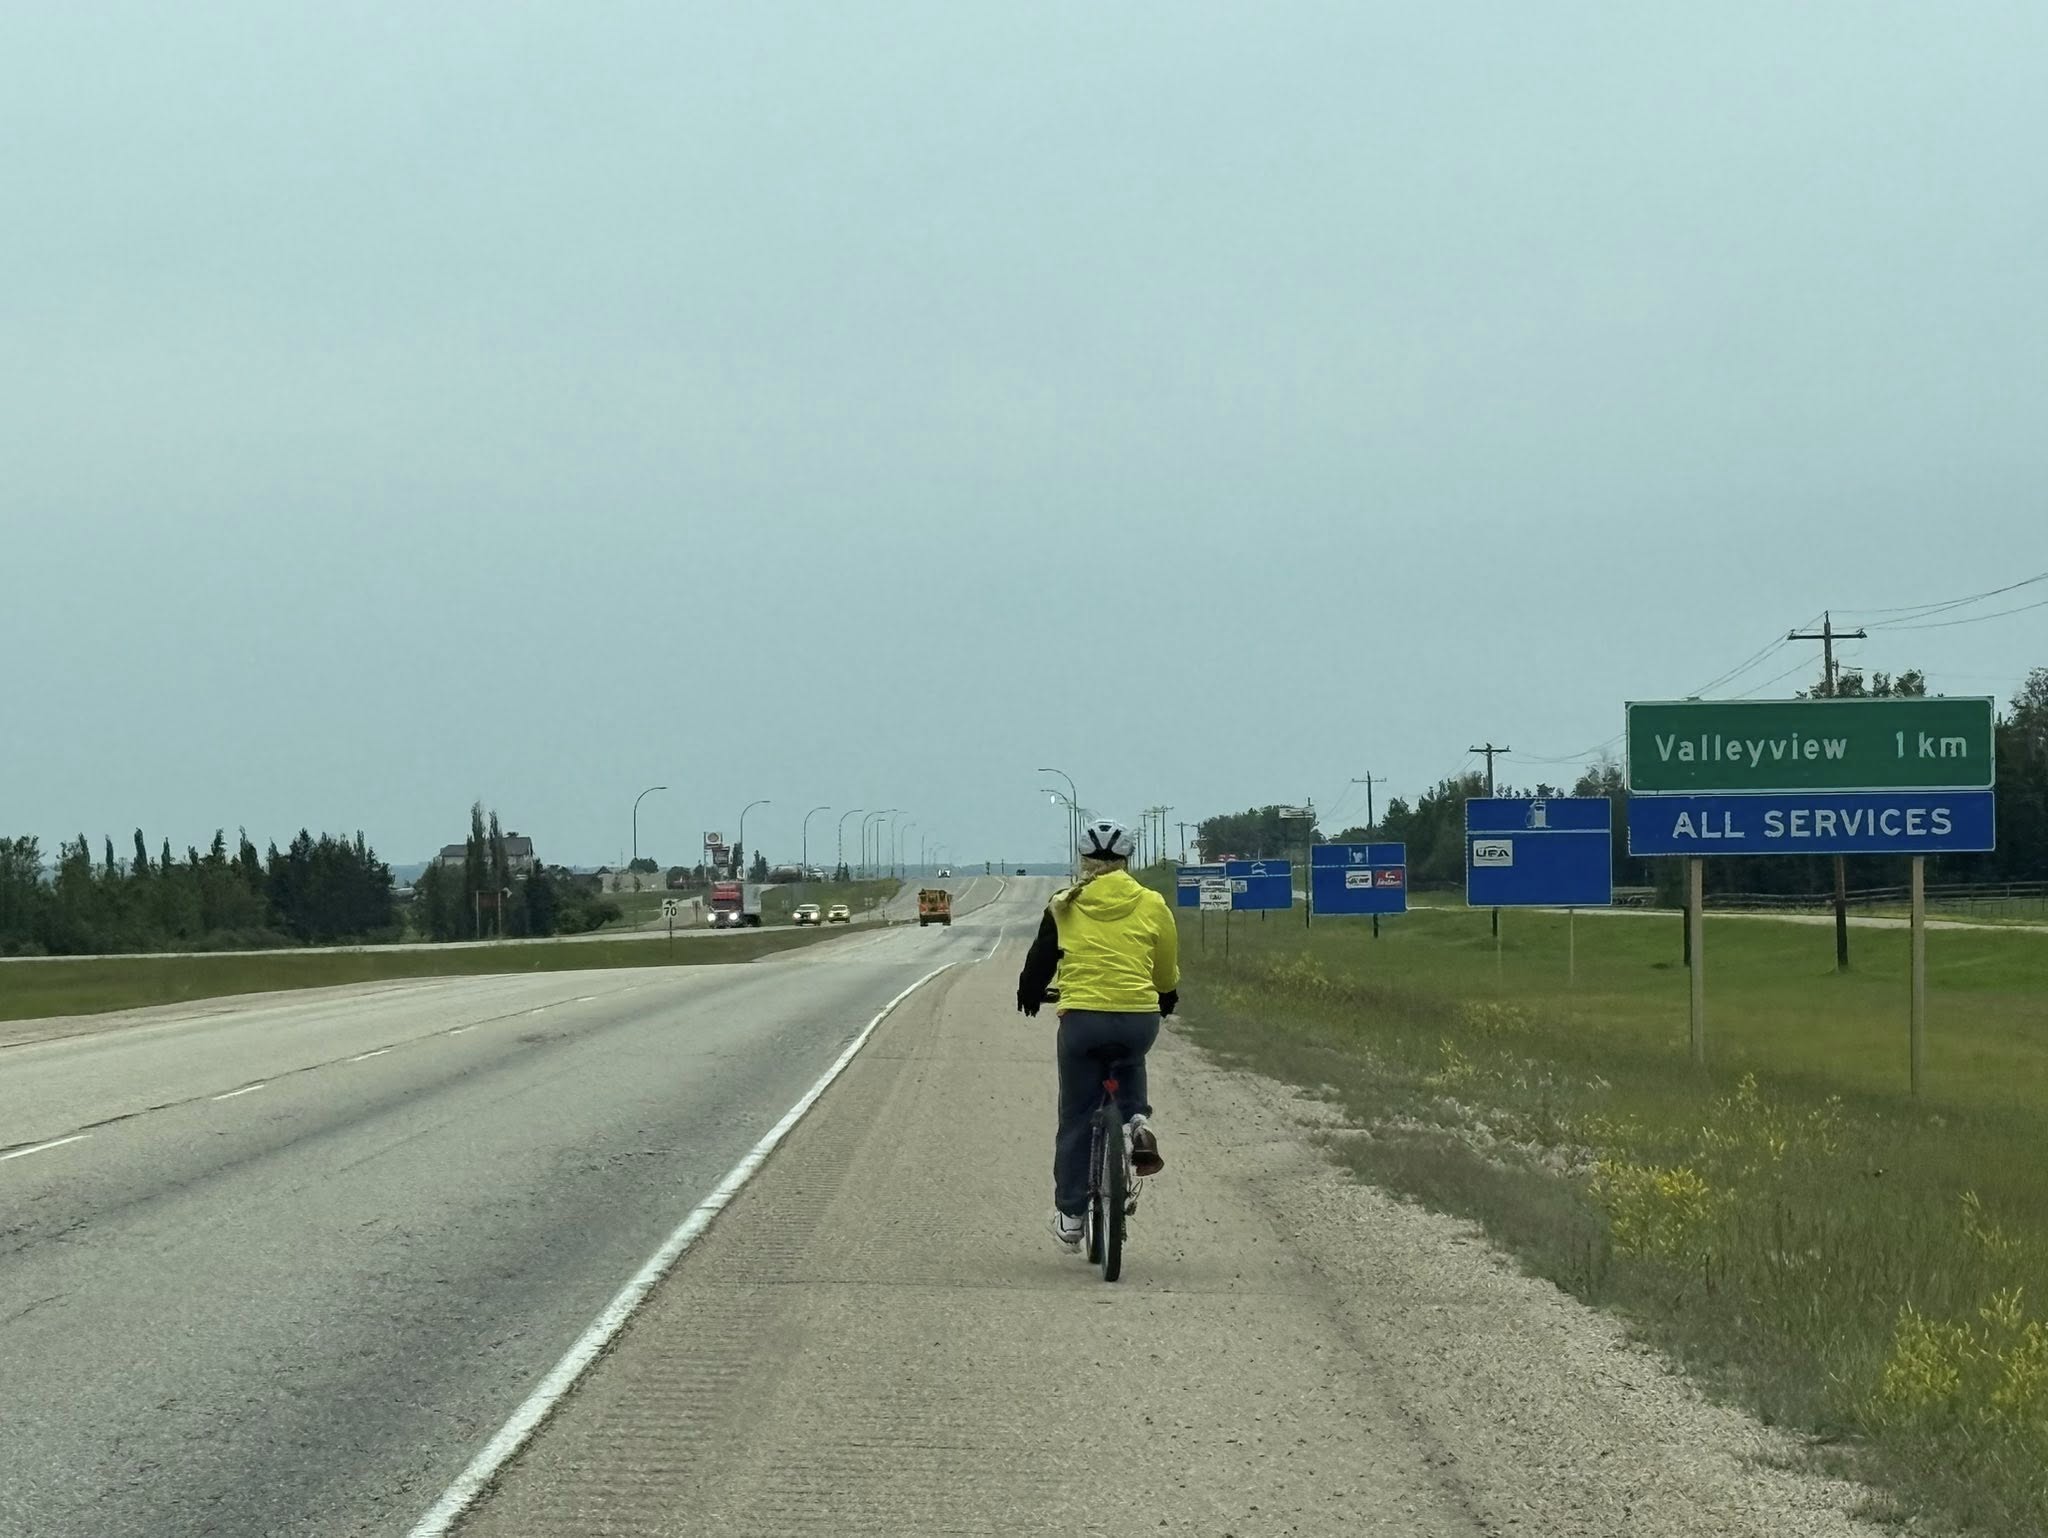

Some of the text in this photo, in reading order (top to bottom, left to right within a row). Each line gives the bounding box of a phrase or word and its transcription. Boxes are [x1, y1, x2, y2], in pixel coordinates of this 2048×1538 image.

[1654, 732, 1848, 768] Valleyview
[1671, 808, 1953, 839] ALL SERVICES
[1475, 848, 1510, 857] UFA
[663, 906, 677, 917] 70
